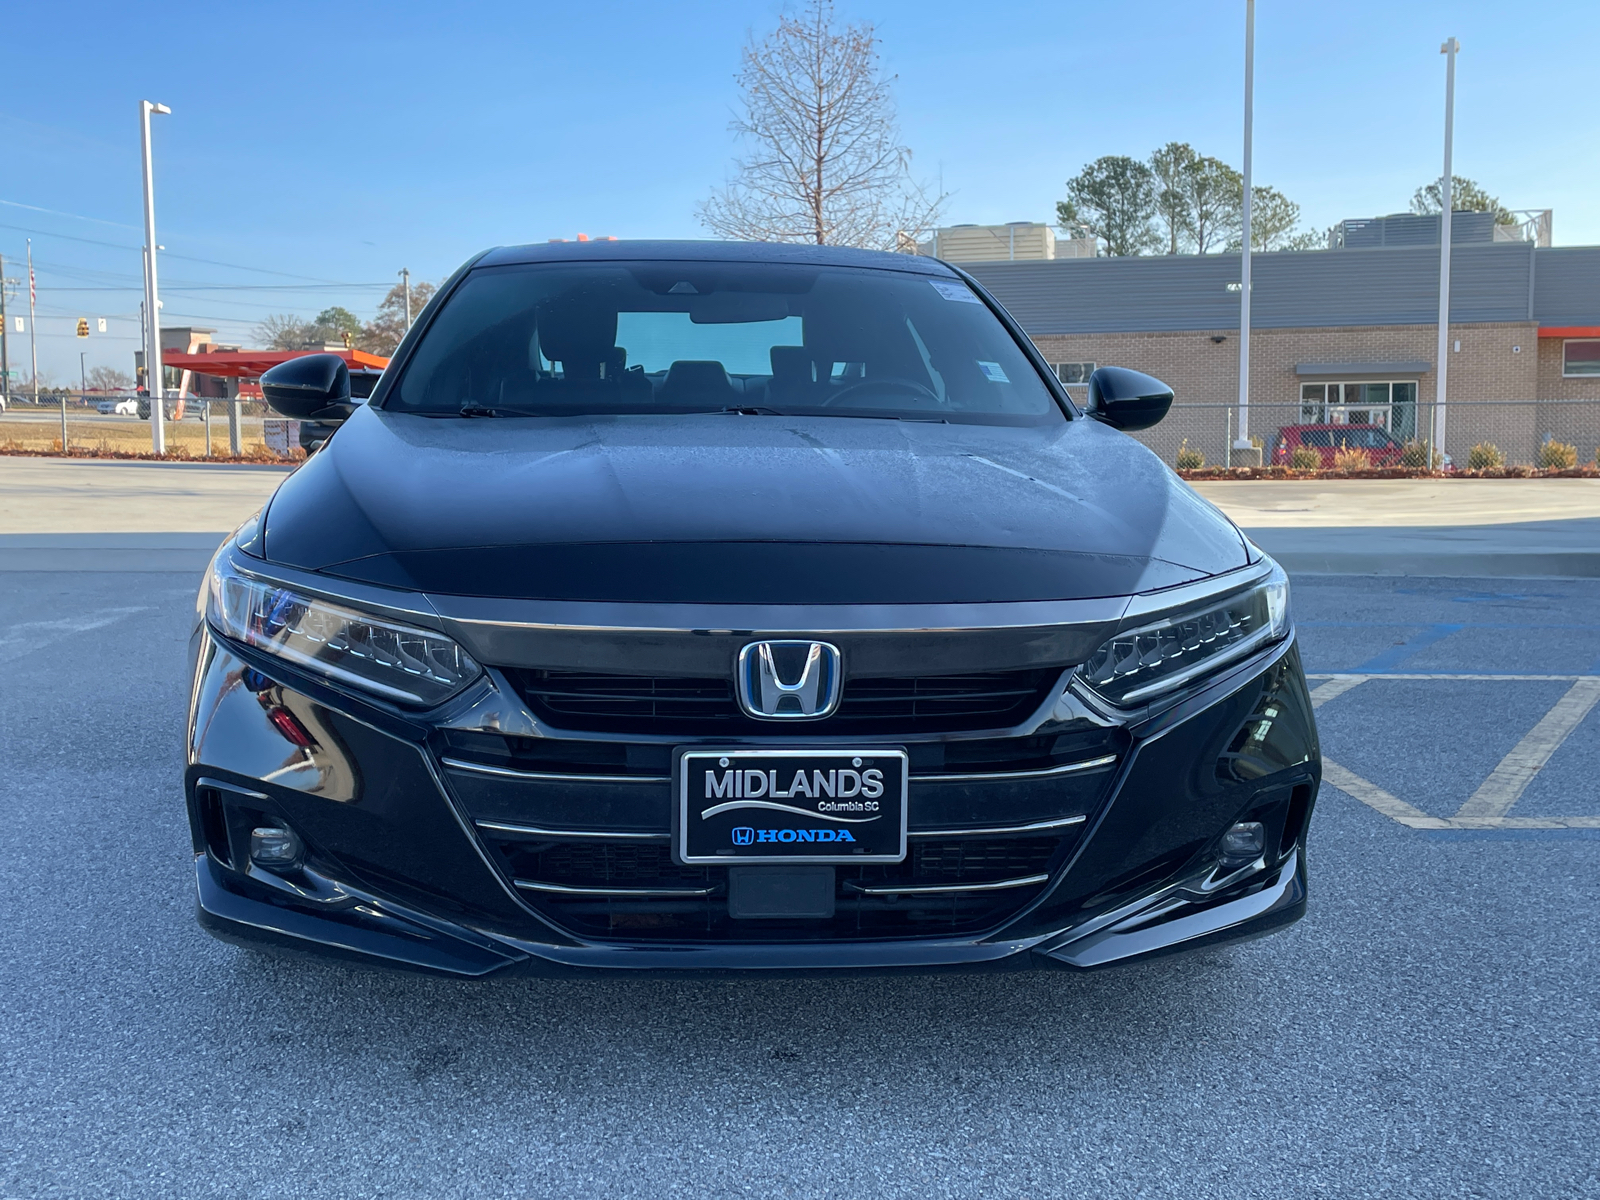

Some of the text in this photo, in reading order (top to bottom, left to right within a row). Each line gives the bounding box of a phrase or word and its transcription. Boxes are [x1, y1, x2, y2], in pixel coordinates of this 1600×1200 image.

[705, 769, 885, 799] MIDLANDS
[818, 801, 880, 812] Columbia SC
[757, 829, 856, 843] HONDA
